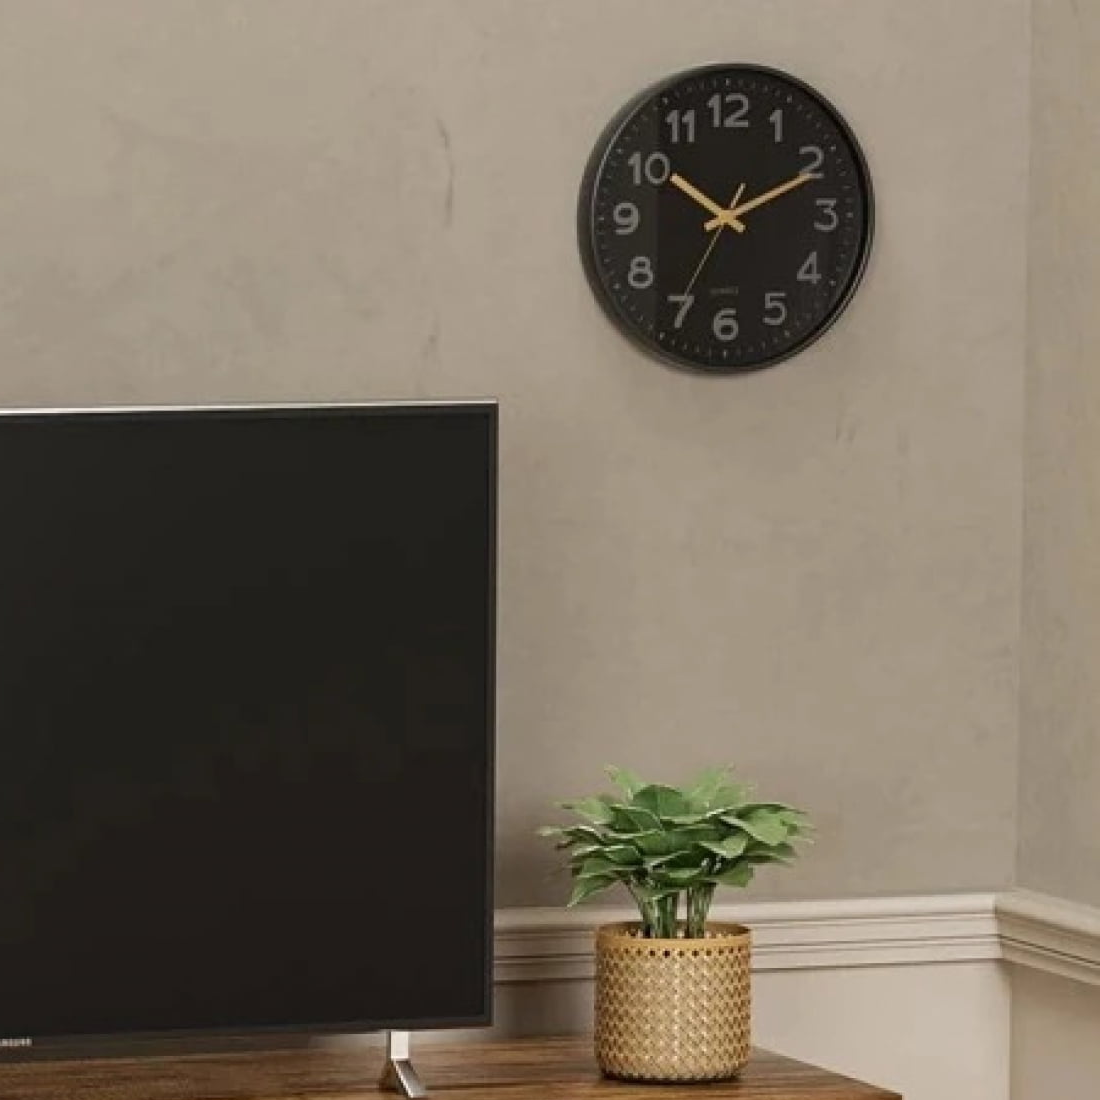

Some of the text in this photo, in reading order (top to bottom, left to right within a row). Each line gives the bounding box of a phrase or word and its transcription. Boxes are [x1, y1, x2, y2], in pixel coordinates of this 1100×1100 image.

[665, 109, 696, 143] 11
[707, 93, 749, 128] 12
[769, 109, 784, 143] 1
[627, 151, 670, 185] 10
[799, 146, 824, 179] 2
[613, 203, 639, 235] 9
[814, 198, 839, 231] 3
[627, 256, 653, 289] 8
[796, 251, 822, 284] 4
[667, 294, 695, 328] 7
[712, 308, 739, 341] 6
[762, 292, 787, 325] 5
